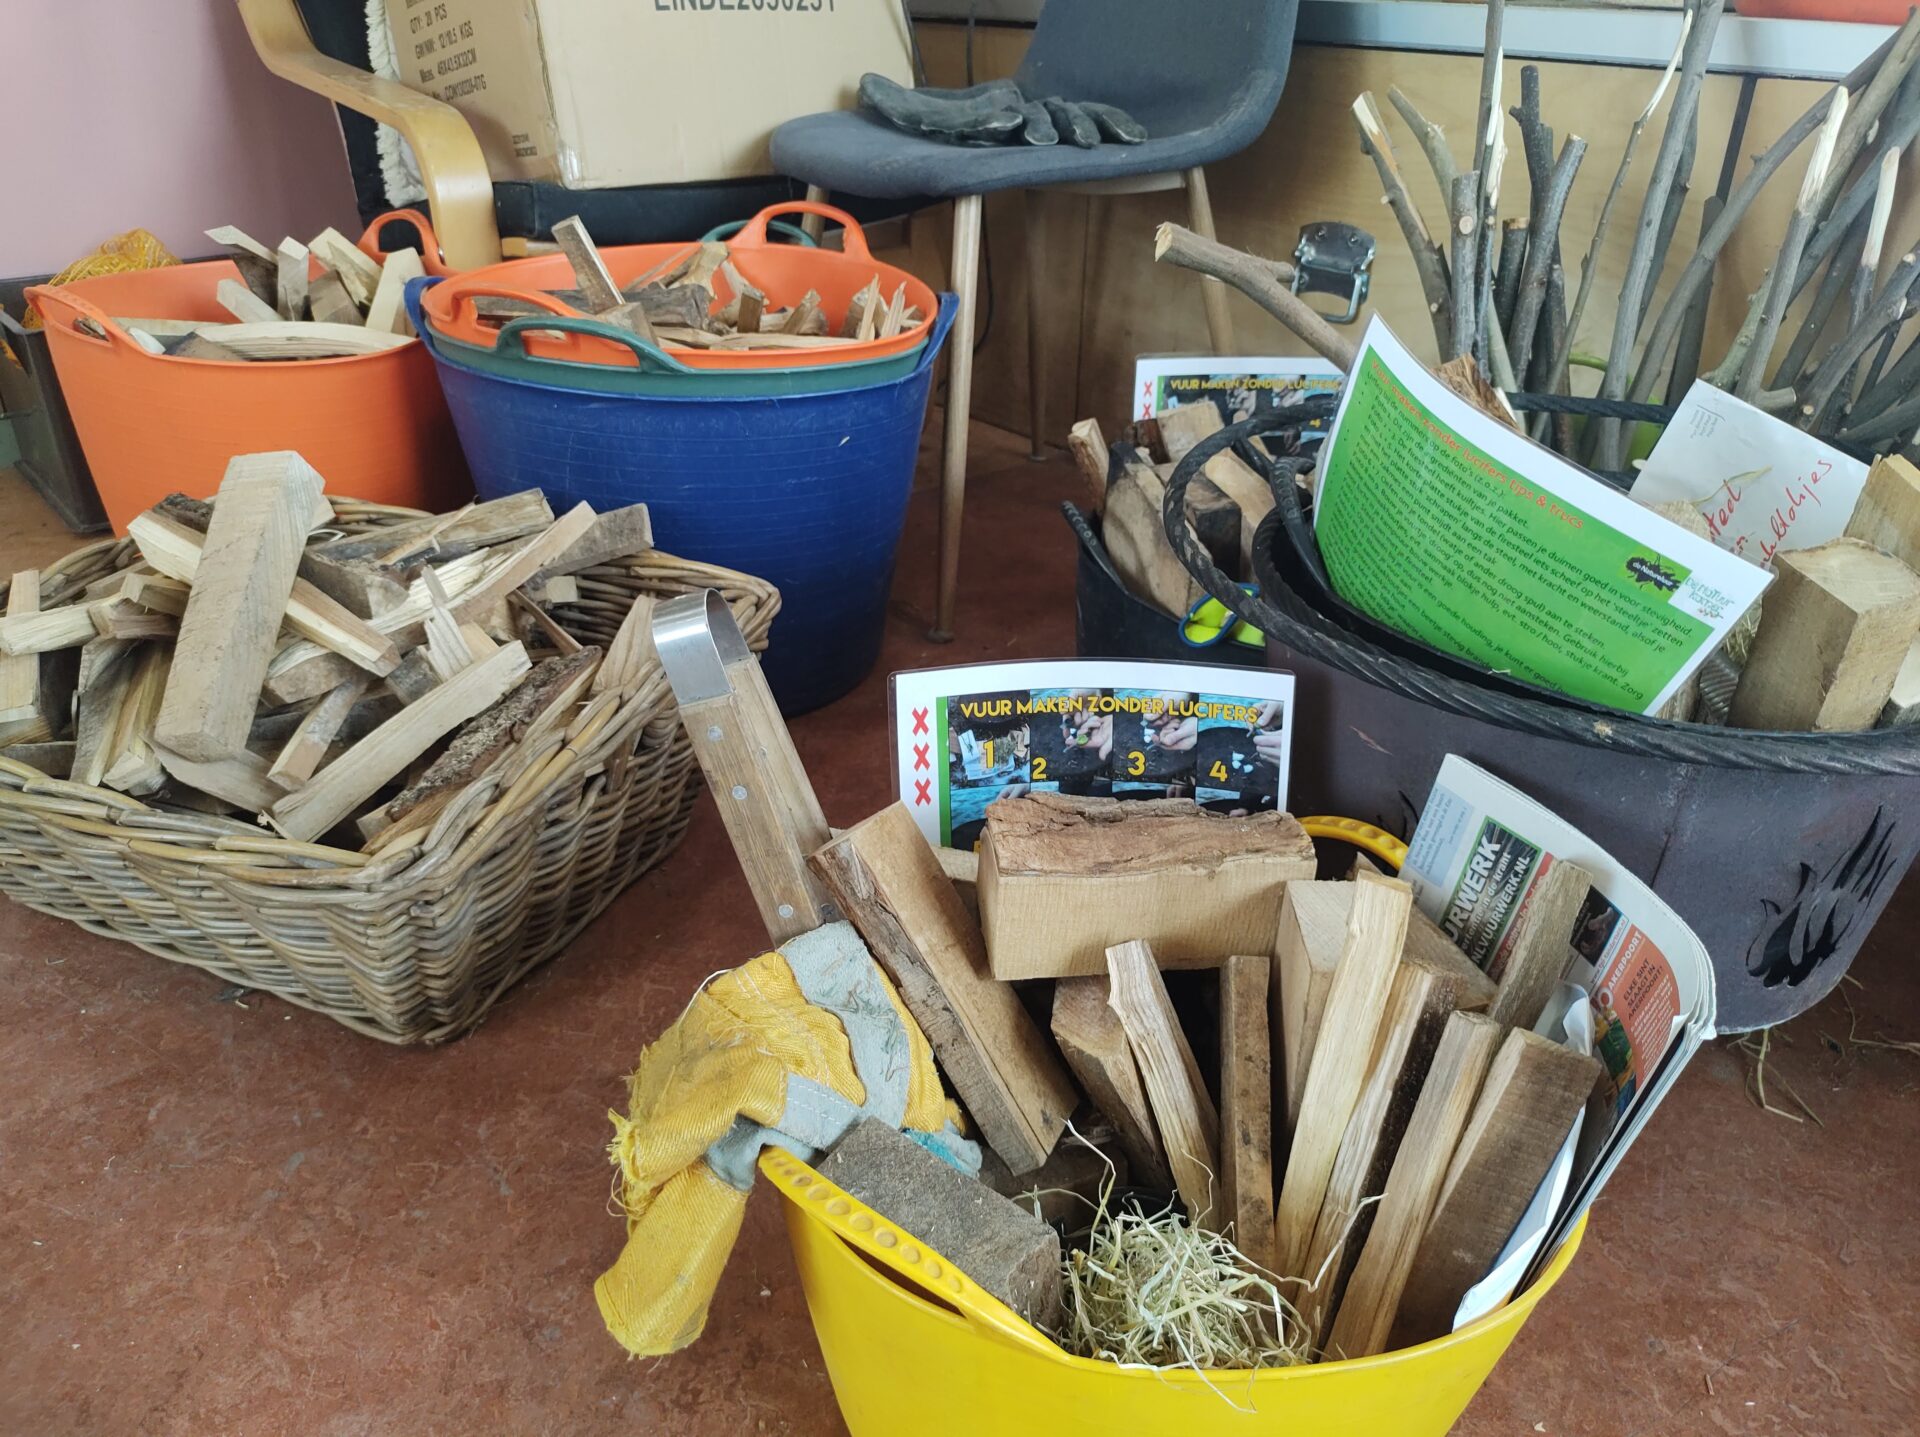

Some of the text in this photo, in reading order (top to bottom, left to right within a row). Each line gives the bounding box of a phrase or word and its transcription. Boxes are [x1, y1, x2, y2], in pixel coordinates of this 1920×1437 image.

[434, 4, 448, 22] PCS
[460, 20, 474, 40] KGS
[1171, 380, 1200, 390] VUUR
[1201, 380, 1240, 390] MAKEN
[1242, 380, 1285, 390] ZONDER
[1392, 385, 1422, 418] maken
[1423, 418, 1462, 451] zonder
[1463, 448, 1506, 483] lucifers
[1510, 480, 1534, 500] tips
[1536, 496, 1546, 508] &
[1550, 504, 1584, 528] trucs
[1398, 411, 1429, 442] nummers
[1430, 440, 1440, 452] op
[1440, 447, 1450, 458] de
[1452, 456, 1474, 477] foto's
[1403, 430, 1414, 444] zijn
[1414, 441, 1424, 451] de
[1473, 488, 1488, 502] van
[1487, 499, 1496, 508] je
[1497, 504, 1528, 529] pakket.
[1390, 460, 1409, 480] platte
[1410, 478, 1424, 494] stuk
[1461, 522, 1482, 542] langs
[1482, 538, 1494, 549] de
[1496, 548, 1518, 567] steel,
[1519, 562, 1538, 578] met
[1538, 572, 1567, 597] kracht
[1567, 594, 1579, 604] en
[1580, 600, 1630, 635] weerstand,
[1631, 630, 1656, 647] alsof
[1654, 643, 1666, 653] je
[1394, 449, 1406, 462] Het
[1423, 478, 1445, 500] platte
[1446, 498, 1469, 518] stukje
[1470, 515, 1485, 528] van
[1485, 526, 1496, 537] de
[1497, 534, 1534, 561] firesteel
[1533, 556, 1550, 571] iets
[1550, 566, 1581, 588] scheef
[1582, 586, 1594, 599] op
[1594, 592, 1612, 607] het
[1651, 626, 1684, 648] zetten
[1398, 439, 1407, 450] De
[1408, 448, 1436, 476] firesteel
[1436, 470, 1455, 490] heeft
[1456, 488, 1485, 514] kuiltjes.
[1489, 513, 1506, 528] Hier
[1506, 526, 1538, 550] passen
[1538, 544, 1547, 554] je
[1548, 550, 1582, 576] duimen
[1583, 572, 1608, 591] goed
[1609, 586, 1619, 596] in
[1620, 592, 1642, 608] voor
[1642, 604, 1692, 638] stevigheid.
[1402, 486, 1414, 500] een
[1414, 500, 1431, 515] punt
[1431, 514, 1451, 532] snijdt
[1452, 531, 1466, 544] aan
[1466, 542, 1482, 554] een
[1483, 554, 1496, 566] tak
[1399, 497, 1410, 509] om
[1418, 514, 1440, 536] tondel
[1440, 534, 1464, 556] (watje
[1464, 553, 1474, 564] of
[1474, 560, 1497, 580] ander
[1498, 578, 1523, 599] droog
[1524, 594, 1546, 613] spul)
[1545, 610, 1562, 624] aan
[1563, 619, 1574, 630] te
[1574, 627, 1606, 650] steken.
[1404, 516, 1426, 538] vuurtje
[1453, 559, 1465, 572] op,
[1466, 569, 1482, 584] dus
[1482, 582, 1498, 597] nog
[1498, 592, 1516, 606] niet
[1516, 604, 1561, 636] aansteken.
[1563, 634, 1600, 660] Gebruik
[1598, 654, 1628, 678] hierbij
[1423, 548, 1456, 576] aanmaak
[1456, 574, 1480, 595] blokje
[1480, 594, 1500, 613] hulp,
[1502, 610, 1516, 622] evt.
[1520, 620, 1536, 634] stro
[1566, 650, 1592, 670] stukje
[1592, 666, 1618, 686] krant.
[1620, 682, 1644, 700] Zorg
[1424, 588, 1437, 600] een
[1438, 600, 1460, 620] goede
[1460, 618, 1494, 648] houding,
[1494, 644, 1504, 652] je
[1504, 651, 1524, 666] kunt
[1524, 665, 1534, 674] er
[1533, 671, 1558, 688] goed
[1442, 630, 1466, 652] stevig
[960, 696, 1258, 723] VUUR MAKEN ZONDER LUCIFERS
[983, 740, 1228, 782] 1 2 3 4
[1461, 852, 1512, 950] ertentie in de krant
[1608, 931, 1642, 990] AKERPOORT
[1624, 958, 1650, 1000] ELKE SINT
[1627, 964, 1656, 1007] SLAAGT IN
